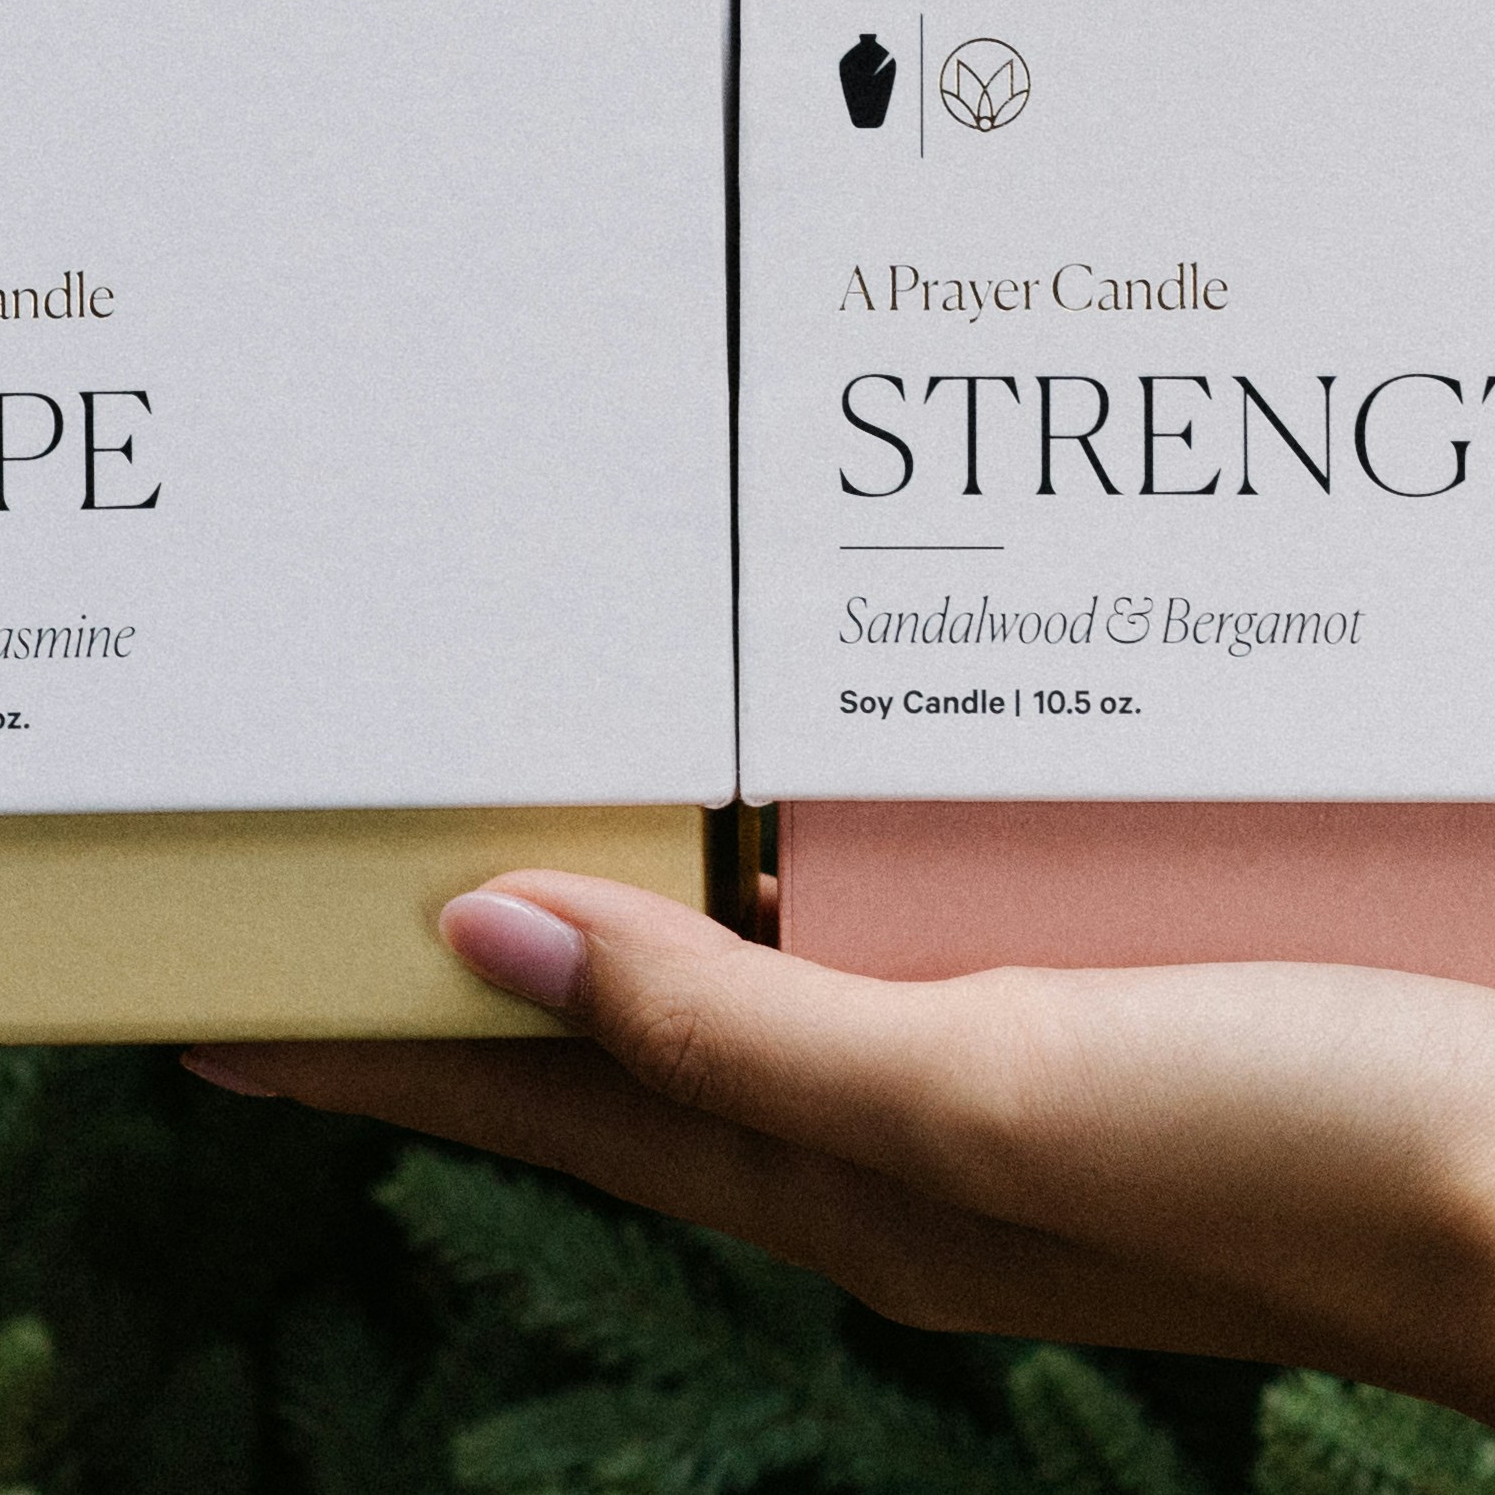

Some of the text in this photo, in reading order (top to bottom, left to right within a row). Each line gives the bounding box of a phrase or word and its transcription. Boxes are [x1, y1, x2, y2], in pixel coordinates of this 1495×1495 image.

[837, 259, 1230, 326] A Prayer Candle
[837, 593, 1367, 659] Sandalwood & Bergamot
[838, 687, 896, 722] Soy
[901, 687, 1007, 717] Candle
[1031, 688, 1093, 717] 10.5
[1098, 694, 1143, 717] oz.
